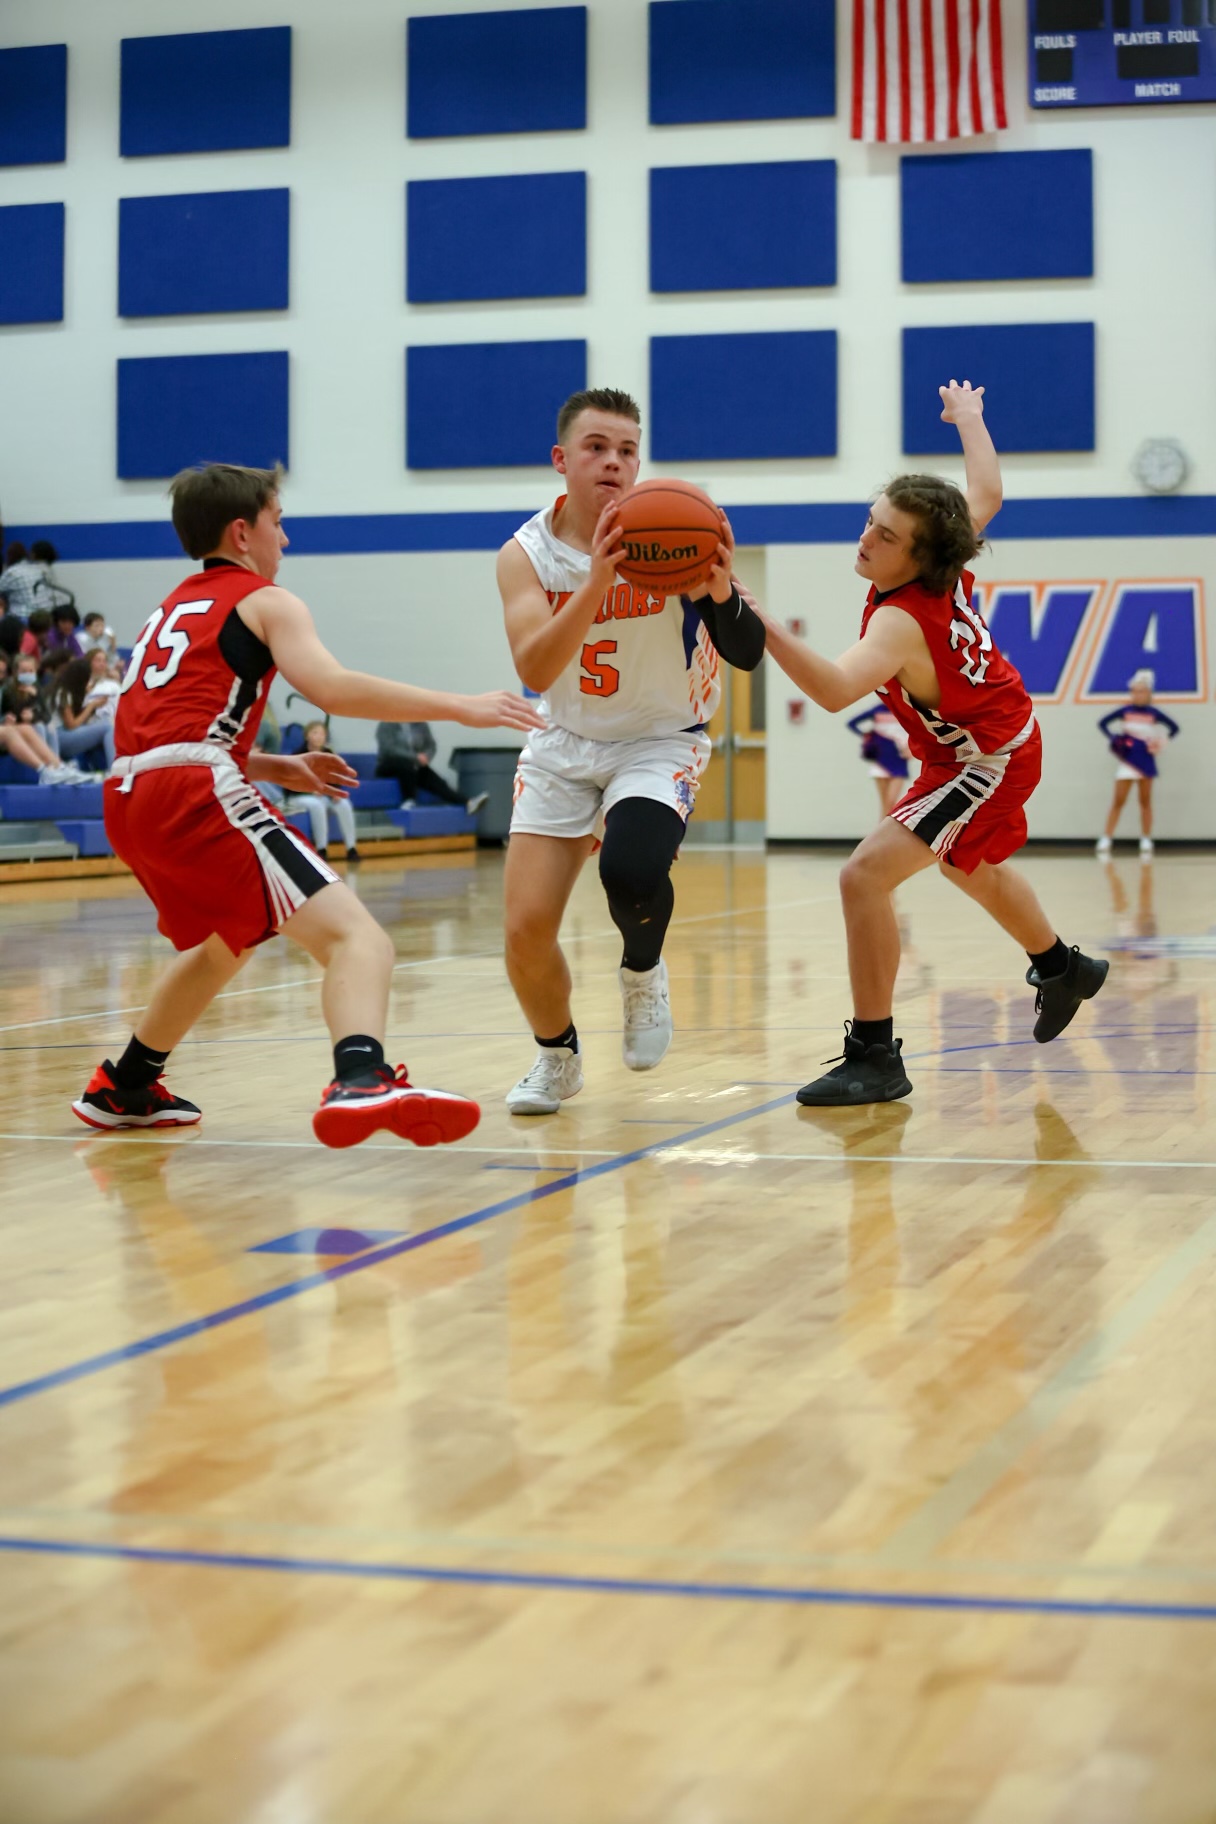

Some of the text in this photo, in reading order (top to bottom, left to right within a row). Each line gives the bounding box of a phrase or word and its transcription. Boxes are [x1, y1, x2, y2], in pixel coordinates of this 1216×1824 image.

[1034, 34, 1077, 49] FOULS
[1113, 29, 1200, 46] PLAYER FOUL
[1034, 86, 1077, 102] SCORE
[1135, 82, 1181, 97] MATCH
[621, 541, 698, 562] Wilson
[579, 639, 620, 698] 5
